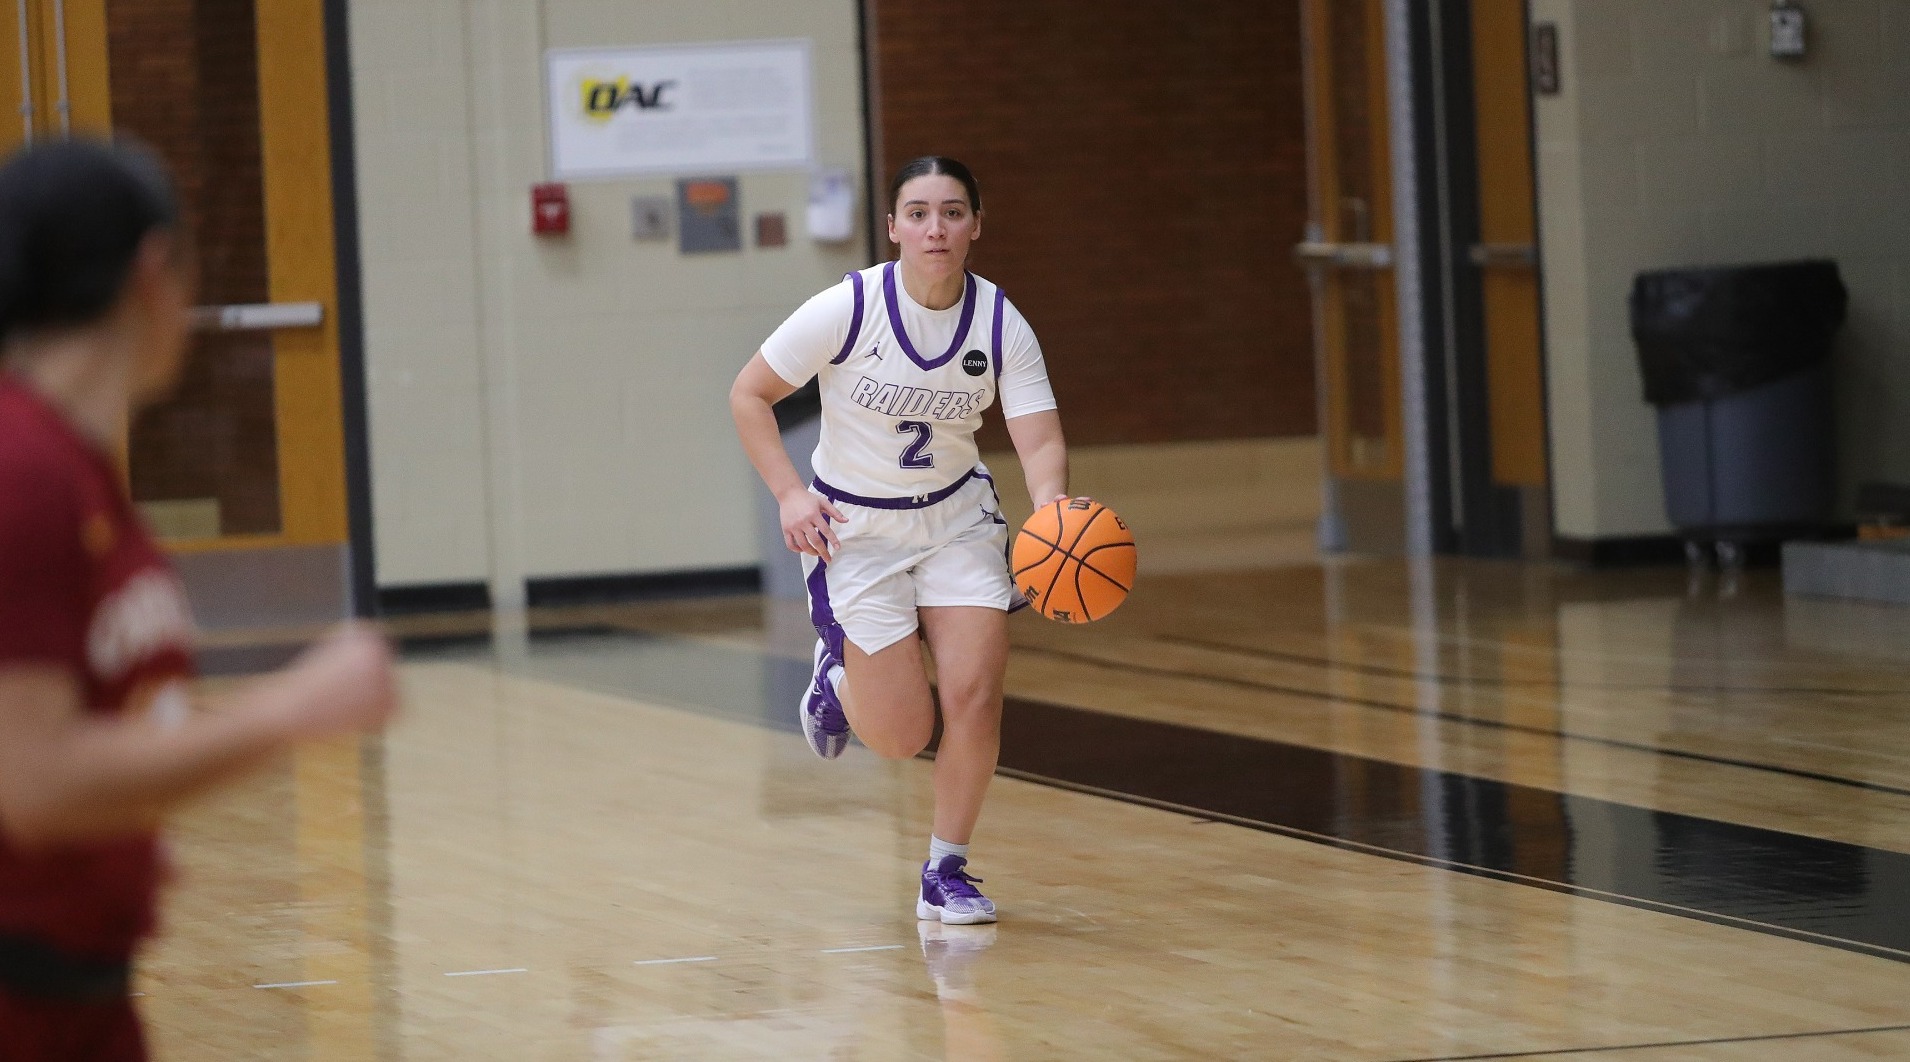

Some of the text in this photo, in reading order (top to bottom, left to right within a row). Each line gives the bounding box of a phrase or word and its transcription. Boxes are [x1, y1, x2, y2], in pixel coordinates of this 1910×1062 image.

[587, 80, 677, 111] OAC
[962, 359, 987, 368] LENNY
[851, 376, 985, 420] RAIDERS
[895, 420, 934, 469] 2
